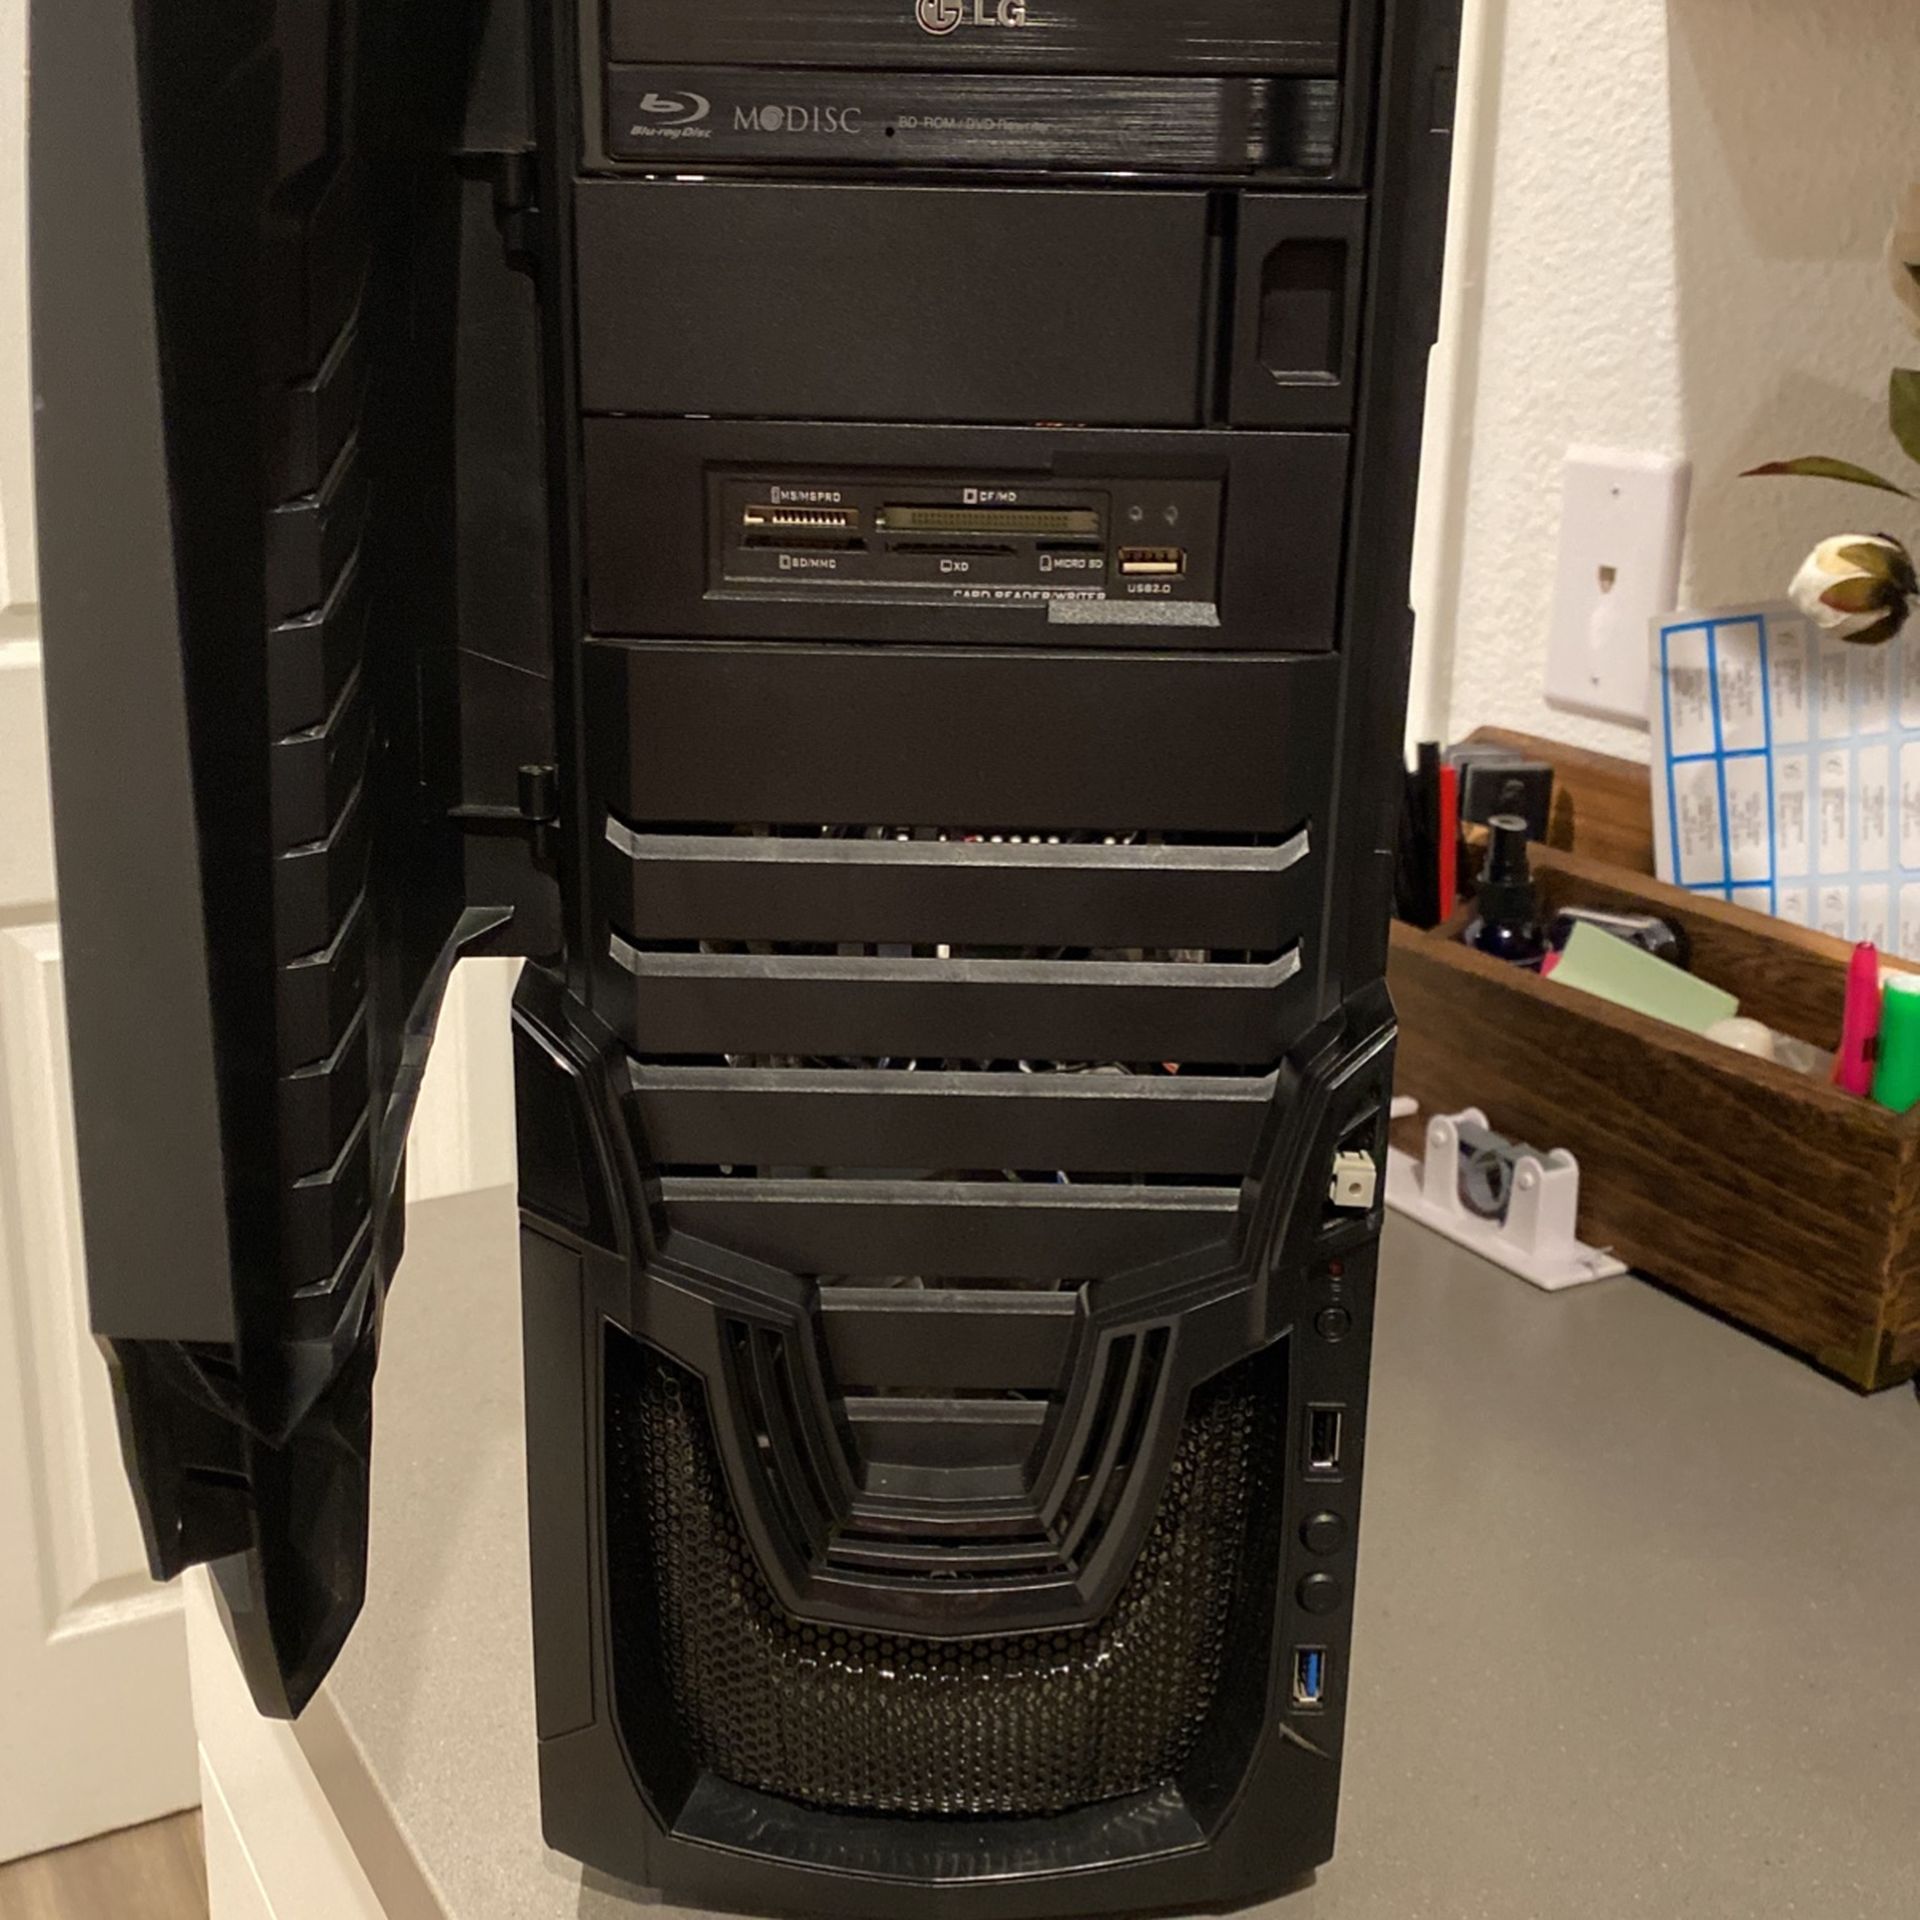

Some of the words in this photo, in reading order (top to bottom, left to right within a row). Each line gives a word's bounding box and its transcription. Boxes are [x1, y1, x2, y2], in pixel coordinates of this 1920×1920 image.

[974, 0, 1026, 27] LG
[953, 561, 969, 571] XD
[1053, 558, 1086, 569] MICRO
[1088, 558, 1104, 569] SD
